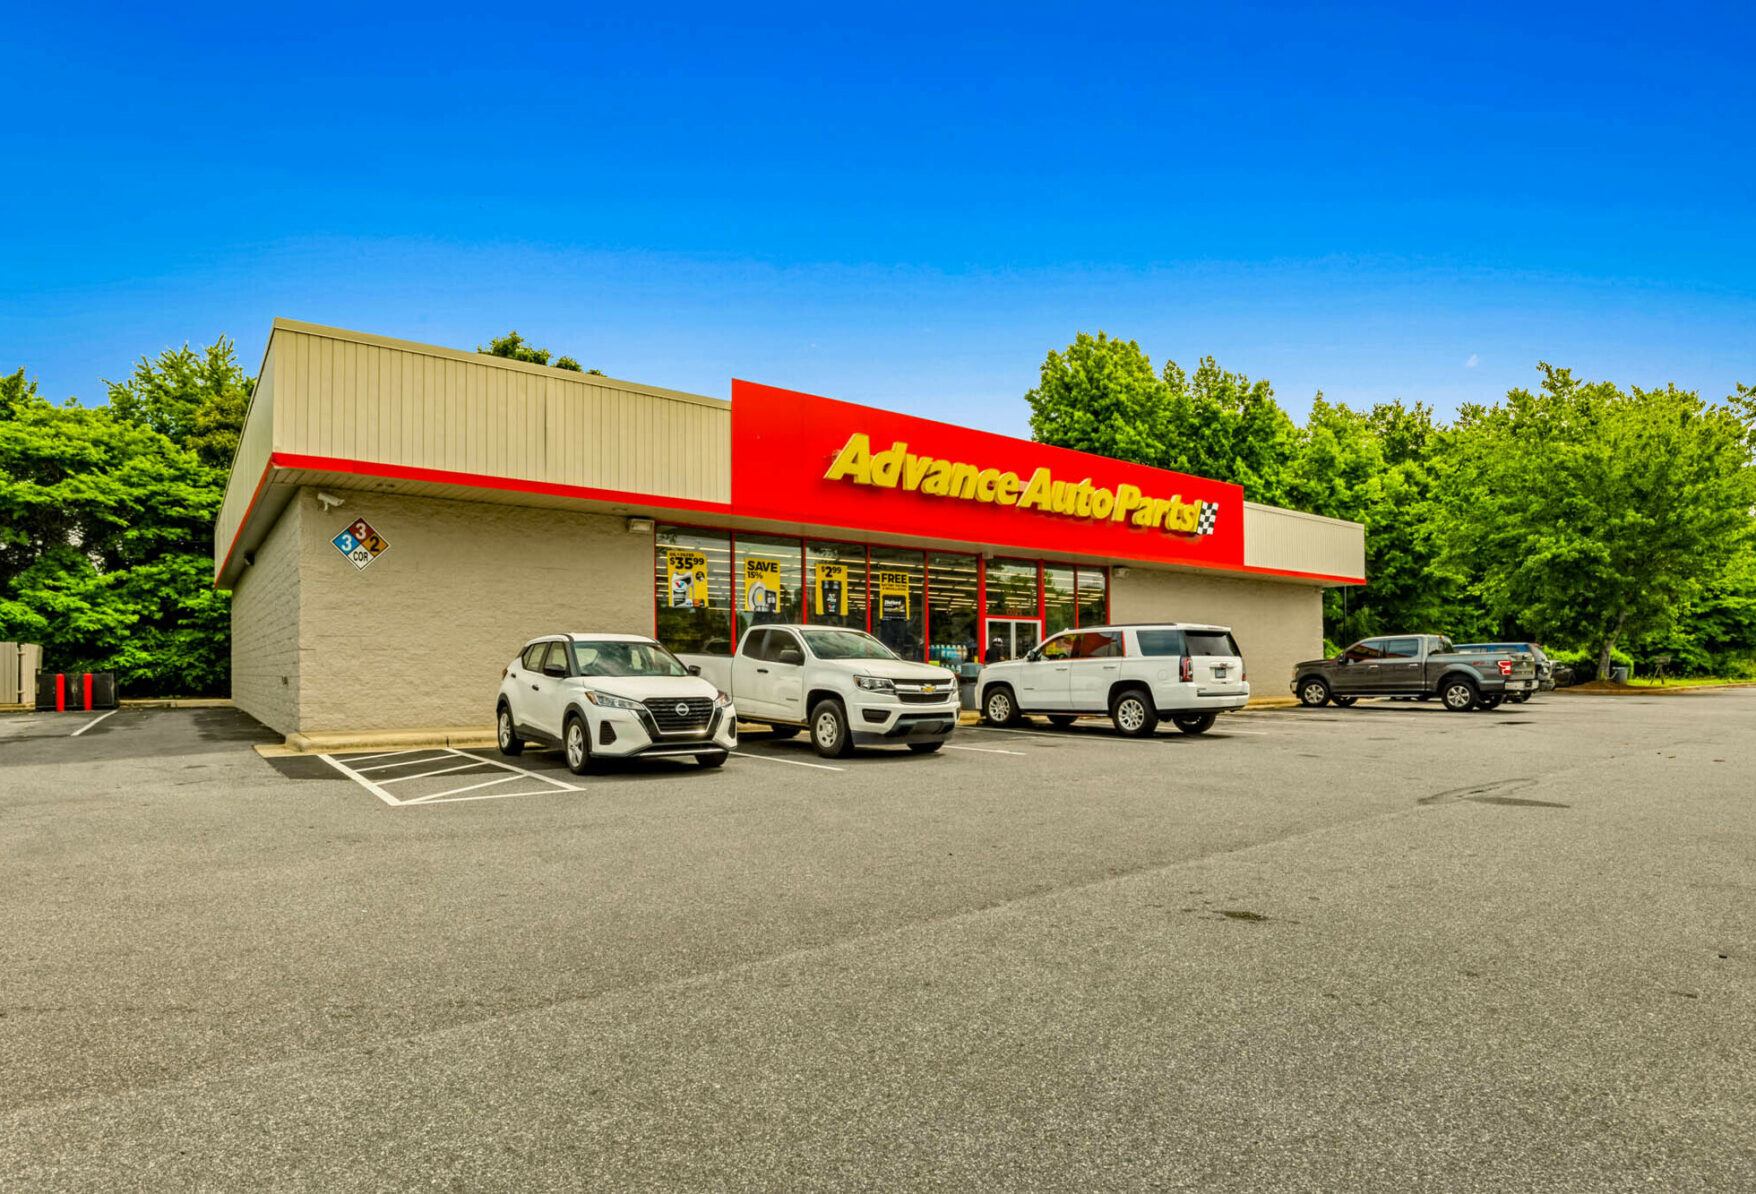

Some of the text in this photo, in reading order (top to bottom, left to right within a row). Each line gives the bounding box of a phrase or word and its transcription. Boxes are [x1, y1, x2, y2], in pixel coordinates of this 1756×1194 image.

[823, 432, 1197, 533] Advance Auto Parts
[355, 522, 366, 540] 3
[341, 534, 380, 552] 3 2
[353, 551, 369, 561] COR
[747, 560, 779, 573] SAVE
[747, 571, 764, 579] 15%
[881, 573, 908, 584] FREE
